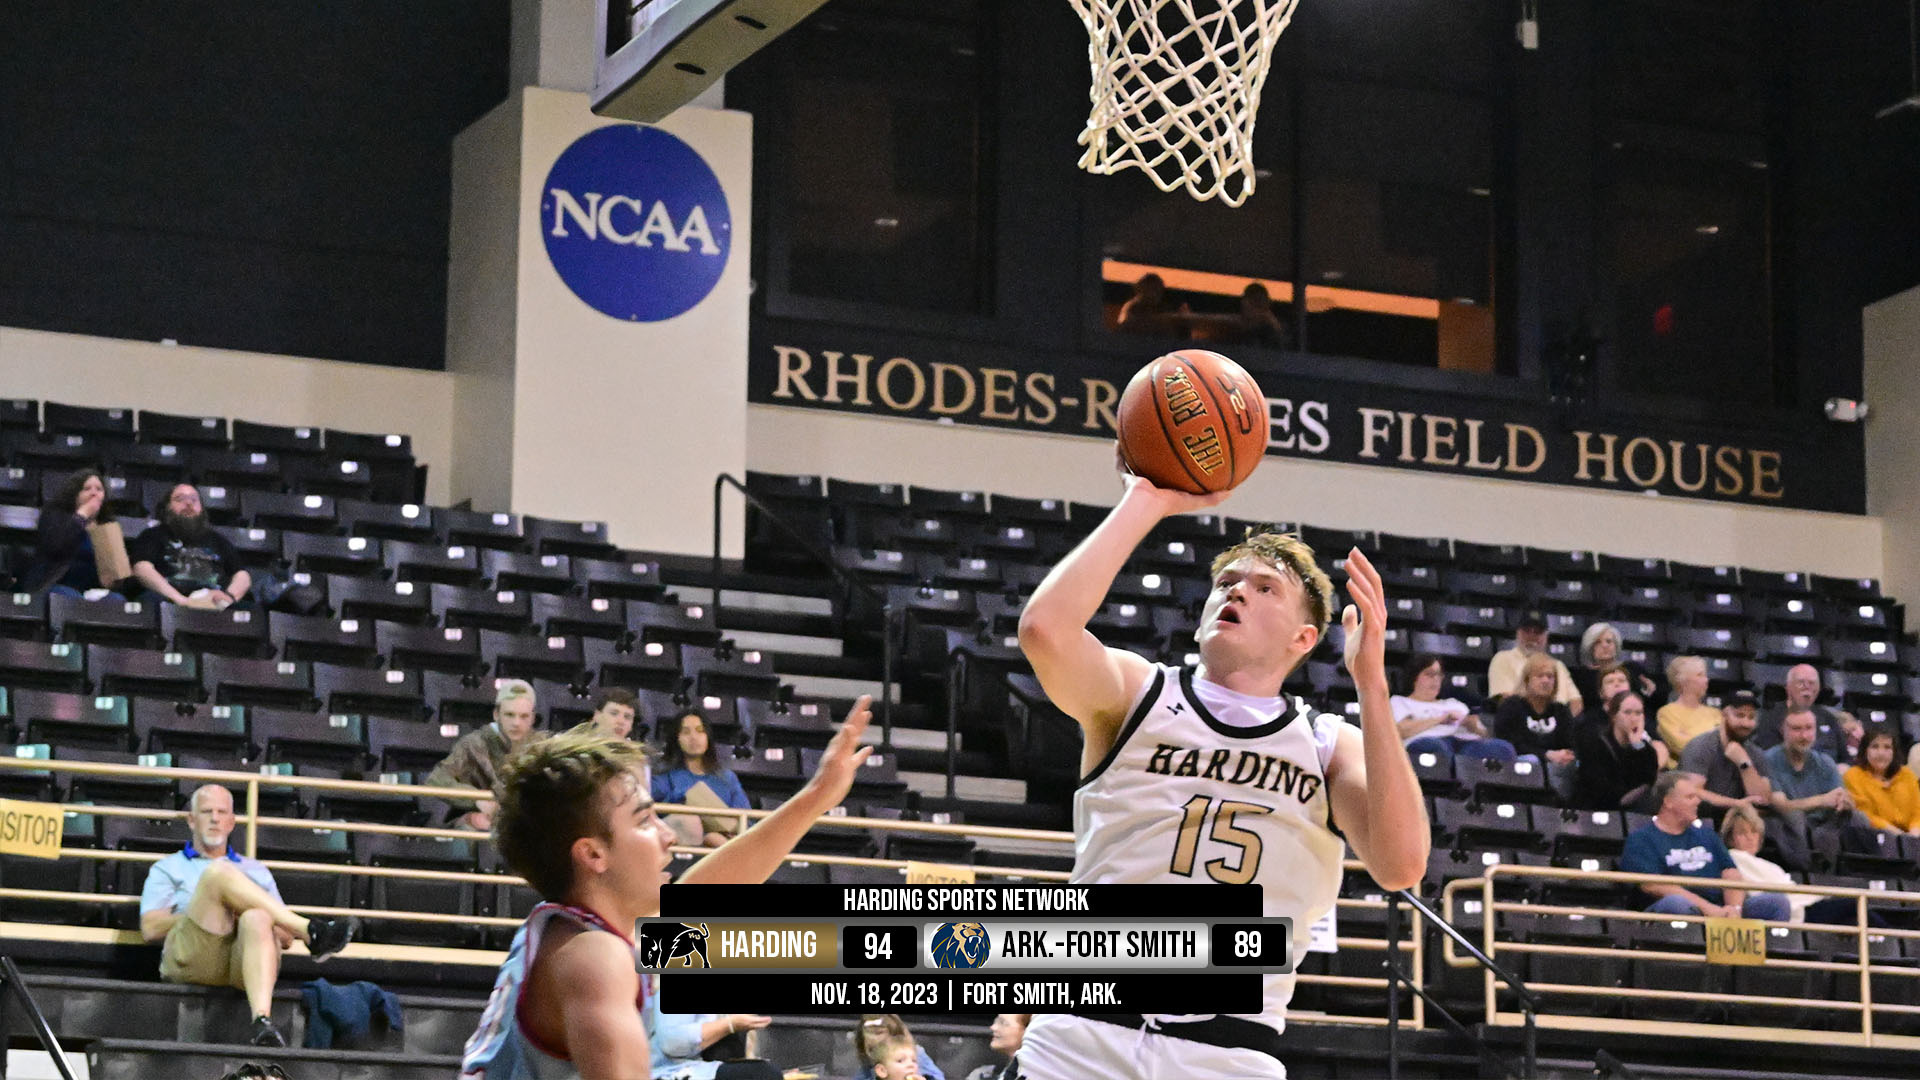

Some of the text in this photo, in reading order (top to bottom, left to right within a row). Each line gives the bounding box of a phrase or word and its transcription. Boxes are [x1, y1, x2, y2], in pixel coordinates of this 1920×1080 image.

[551, 188, 720, 255] NCAA
[1164, 370, 1224, 476] THE ROCK
[1357, 407, 1547, 474] FIELD
[1574, 430, 1784, 499] HOUSE
[1145, 743, 1322, 804] HARDING
[0, 810, 58, 848] ISITOR
[1169, 793, 1275, 884] 15
[1709, 926, 1762, 955] HOME
